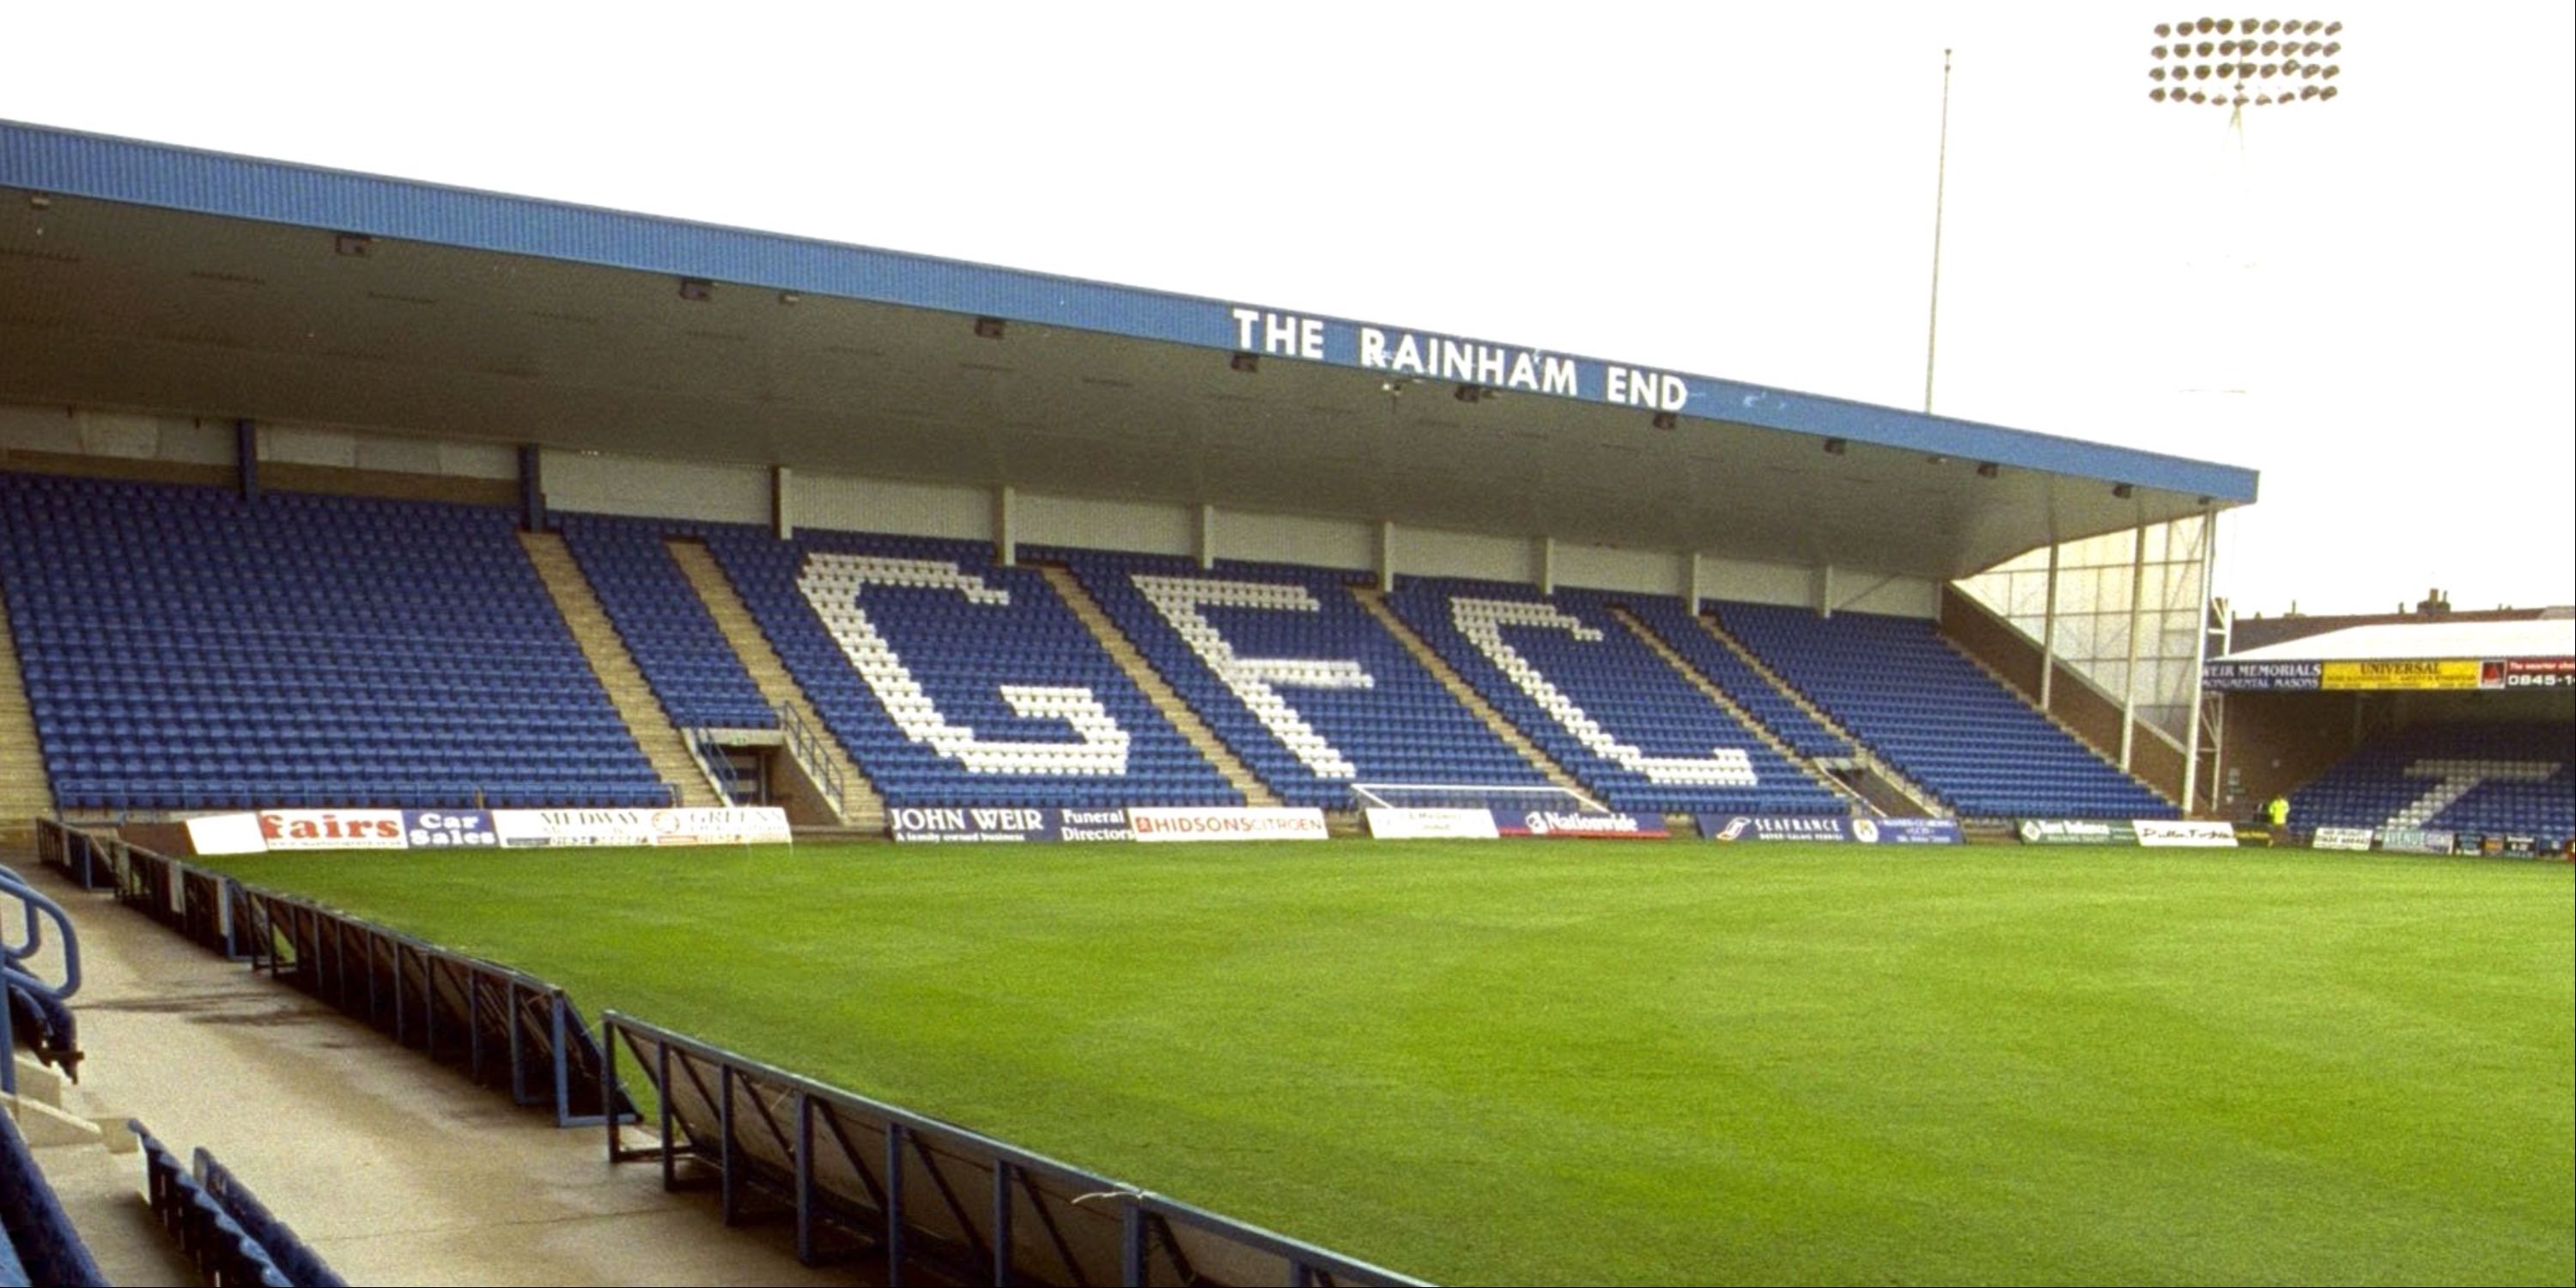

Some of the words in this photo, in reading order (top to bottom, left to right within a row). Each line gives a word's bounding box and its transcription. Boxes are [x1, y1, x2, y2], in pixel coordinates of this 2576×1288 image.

[1233, 309, 1323, 360] THE
[1361, 327, 1577, 395] RAINHAM
[1607, 366, 1688, 411] END
[2239, 663, 2322, 677] MEMORIALS
[2360, 663, 2442, 675] UNIVERSAL
[2274, 677, 2319, 688] MASONS
[418, 812, 480, 829] Car
[541, 811, 639, 825] MEDWAY
[890, 808, 966, 830] JOHN
[971, 808, 1044, 831] WEIR
[1061, 809, 1124, 824] Funeral
[1544, 811, 1638, 832] Nationwide
[1753, 817, 1842, 832] SEAFRANCE
[259, 814, 400, 839] fairs
[409, 828, 496, 846] Sales
